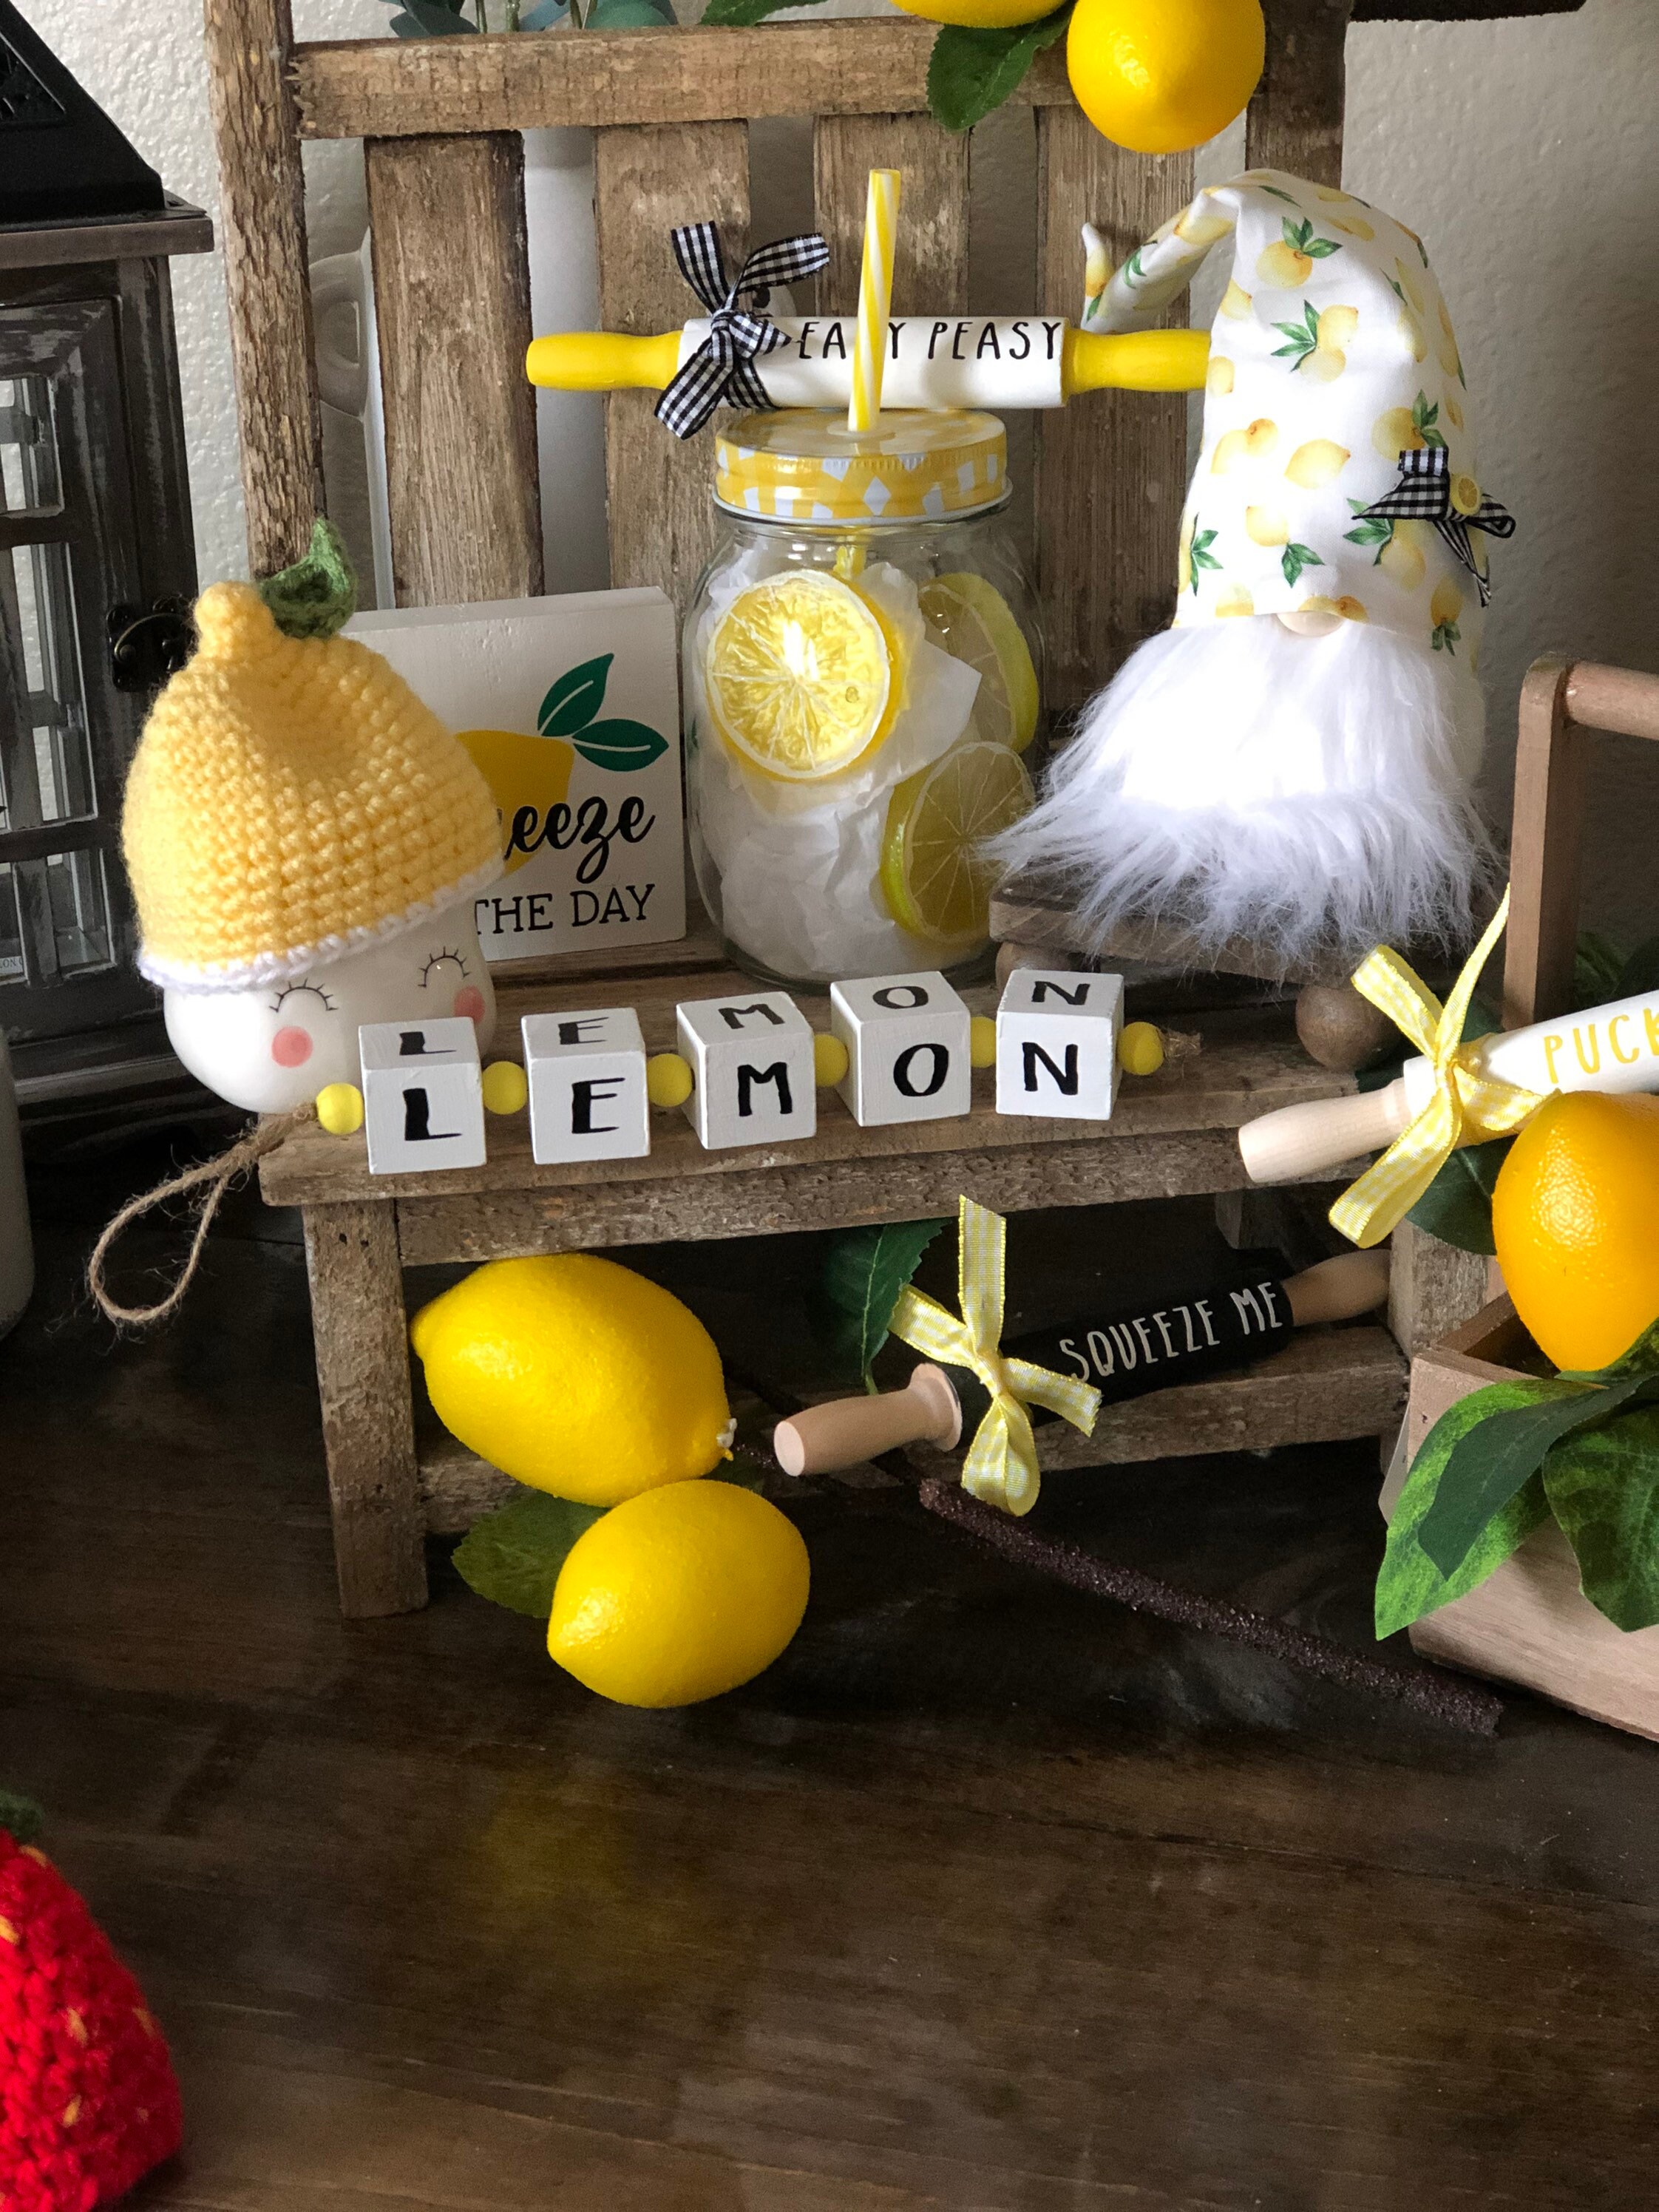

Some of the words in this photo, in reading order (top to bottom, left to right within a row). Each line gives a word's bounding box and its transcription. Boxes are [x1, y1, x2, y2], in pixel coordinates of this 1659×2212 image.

[798, 321, 906, 360] EAY
[927, 321, 1062, 360] PEASY
[497, 795, 657, 884] eeze
[569, 883, 656, 927] DAY
[399, 980, 1091, 1056] LEMON
[402, 1042, 1079, 1141] LEMON
[1059, 1299, 1221, 1382] SQUEEZE
[1229, 1281, 1283, 1335] ME
